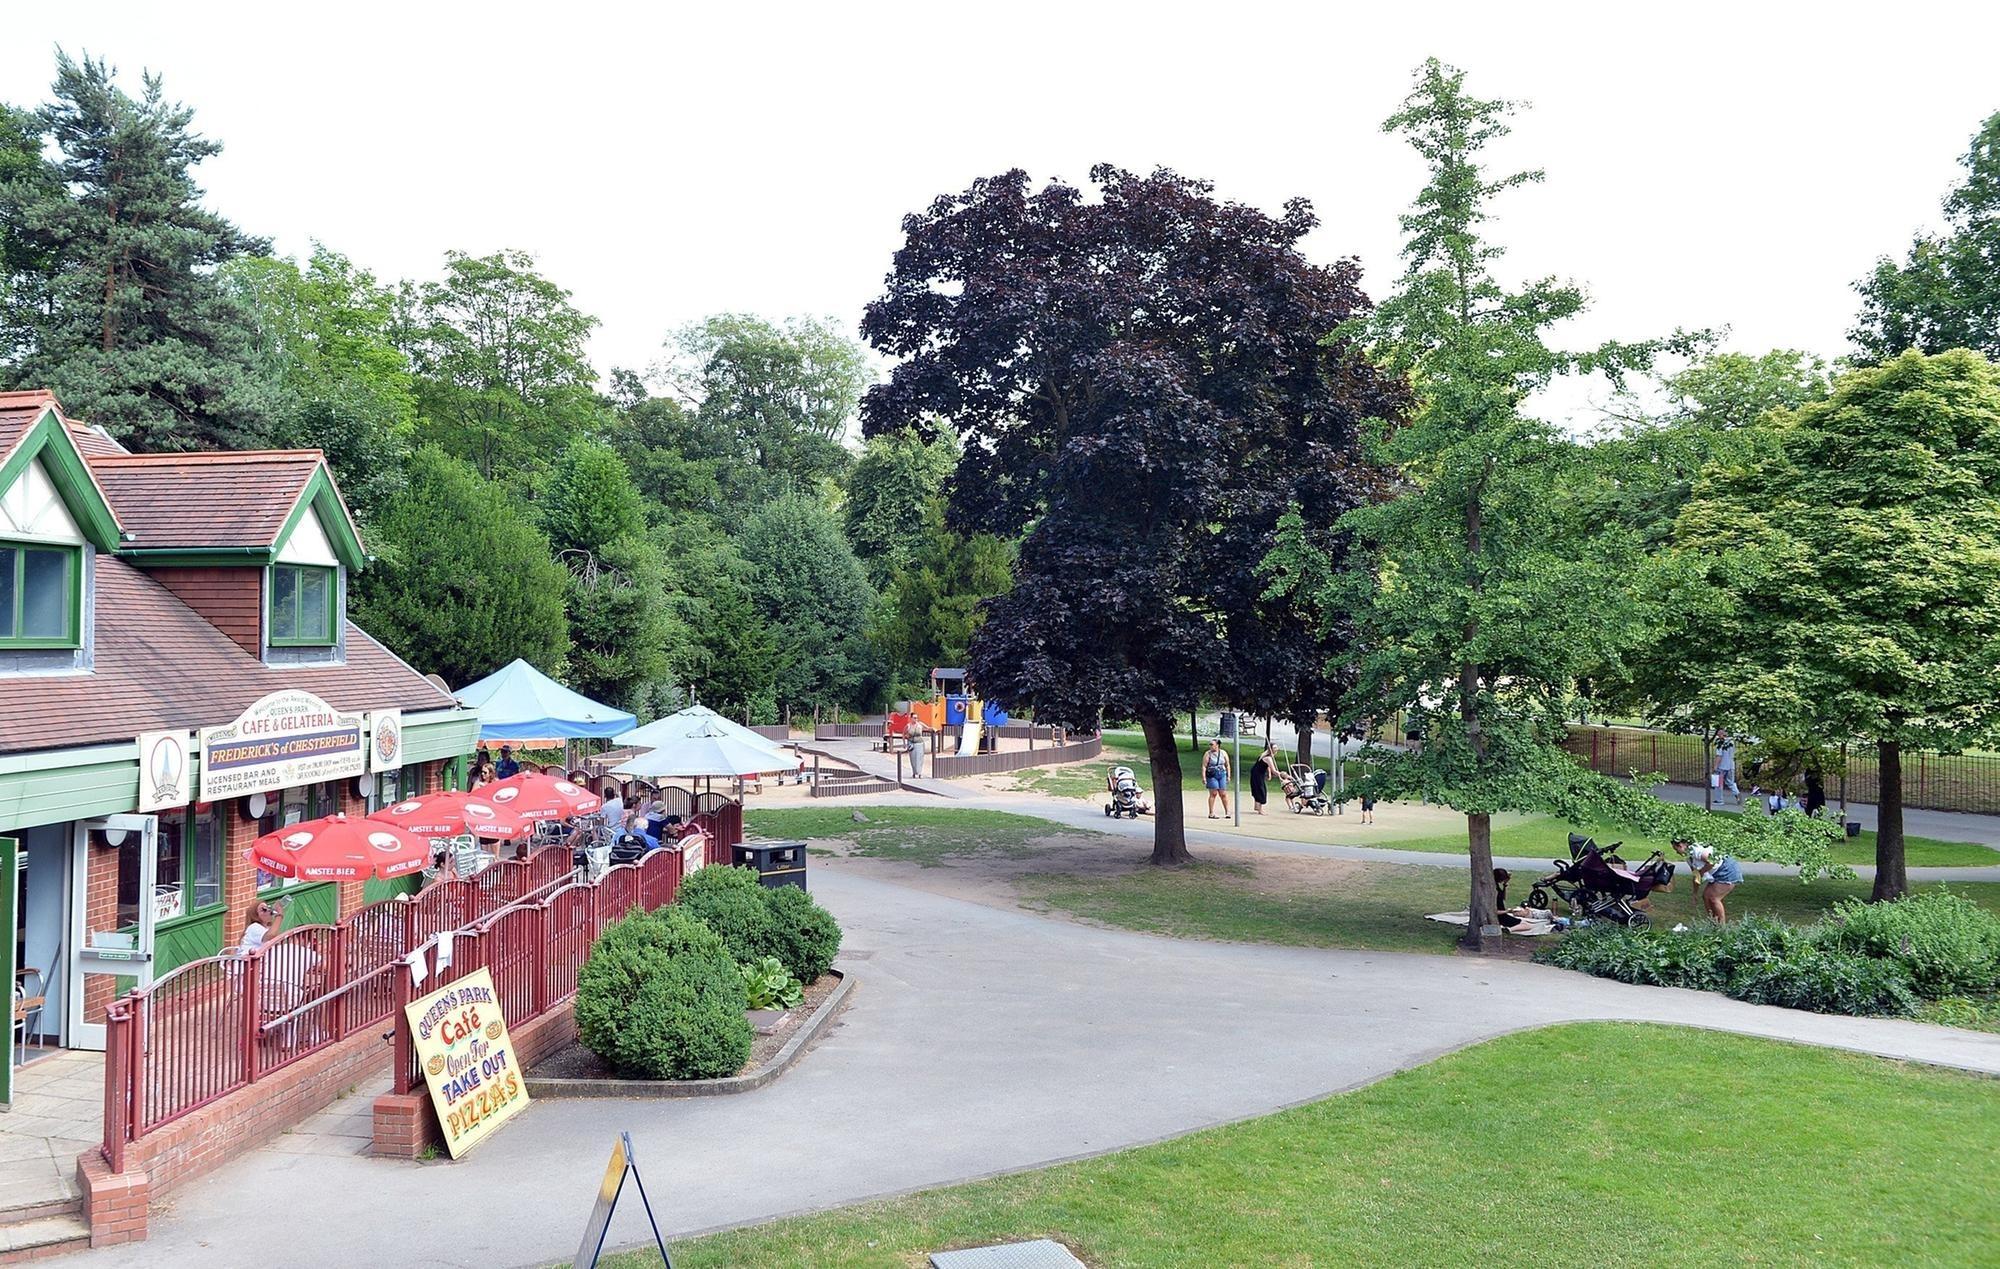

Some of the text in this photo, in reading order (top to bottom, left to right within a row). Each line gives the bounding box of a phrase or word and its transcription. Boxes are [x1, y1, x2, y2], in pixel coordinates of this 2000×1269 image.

[242, 714, 270, 735] CAFÉ
[273, 718, 279, 731] &
[281, 713, 334, 730] GELATERIA
[210, 742, 280, 764] FREDERICK'S
[280, 740, 289, 755] of
[289, 733, 357, 753] CHESTERFIELD
[207, 767, 277, 786] LICENSED BAR AND
[207, 776, 281, 796] RESTAURANT MEALS
[305, 867, 356, 876] AMSTEL BIER
[418, 986, 492, 1040] QUEEN'S PARK
[441, 1006, 482, 1045] Café
[447, 1039, 489, 1077] Open For
[442, 1049, 507, 1106] TAKE OUT
